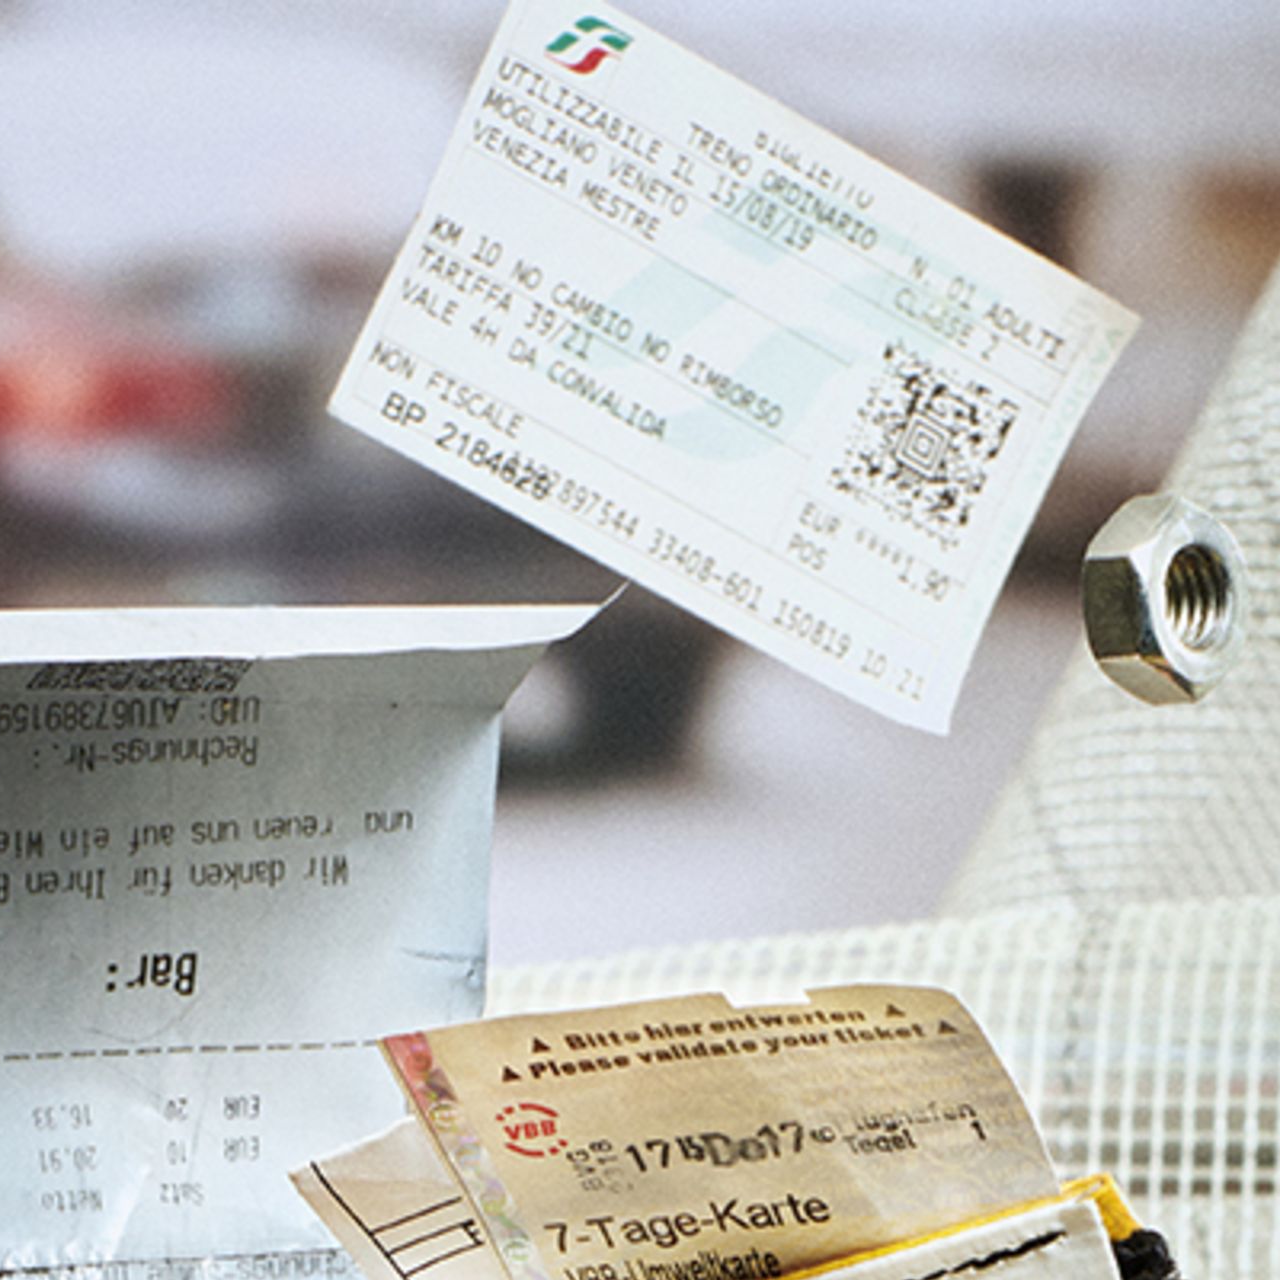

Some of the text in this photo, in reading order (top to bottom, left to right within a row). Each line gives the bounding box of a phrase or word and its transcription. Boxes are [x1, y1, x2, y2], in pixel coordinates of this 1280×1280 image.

[481, 85, 688, 216] MOGLIANO VENETO
[473, 118, 660, 241] VENEZIA MESTRE
[497, 55, 662, 164] UTILIZZABILE
[670, 153, 694, 186] IL
[709, 174, 816, 251] 15/08/19
[979, 331, 1001, 361] 2
[688, 121, 752, 177] TRENO
[760, 168, 878, 250] ORDINARIO
[946, 274, 977, 311] 01
[982, 301, 1066, 360] ADULTI
[418, 242, 598, 361] TARIFFA 39/21
[428, 215, 782, 428] KM 10 NO CAMBIO NO RIMBORSO
[401, 276, 667, 441] VALE 4H DA CONVALIDA
[368, 339, 524, 439] NON FISCALE
[380, 390, 427, 426] BP
[798, 500, 841, 534] EUR
[787, 531, 828, 571] POS
[771, 598, 851, 659] 150819
[58, 826, 109, 857] ein
[128, 823, 174, 856] auf
[190, 819, 239, 844] uns
[24, 867, 105, 899] Ihren
[127, 865, 171, 896] für
[188, 859, 285, 890] danken
[307, 855, 347, 885] Wir
[105, 952, 197, 995] Bar:
[564, 1010, 865, 1050] Bitte hier entwerten
[528, 1023, 925, 1079] Please validate your ticket
[166, 1097, 187, 1114] 20
[223, 1095, 260, 1119] EUR
[503, 1119, 556, 1146] VBB
[970, 1120, 986, 1140] 1
[223, 1135, 259, 1162] EUR
[625, 1139, 670, 1172] 17
[40, 1188, 102, 1212] Netto
[543, 1193, 830, 1252] 7-Tage-Karte
